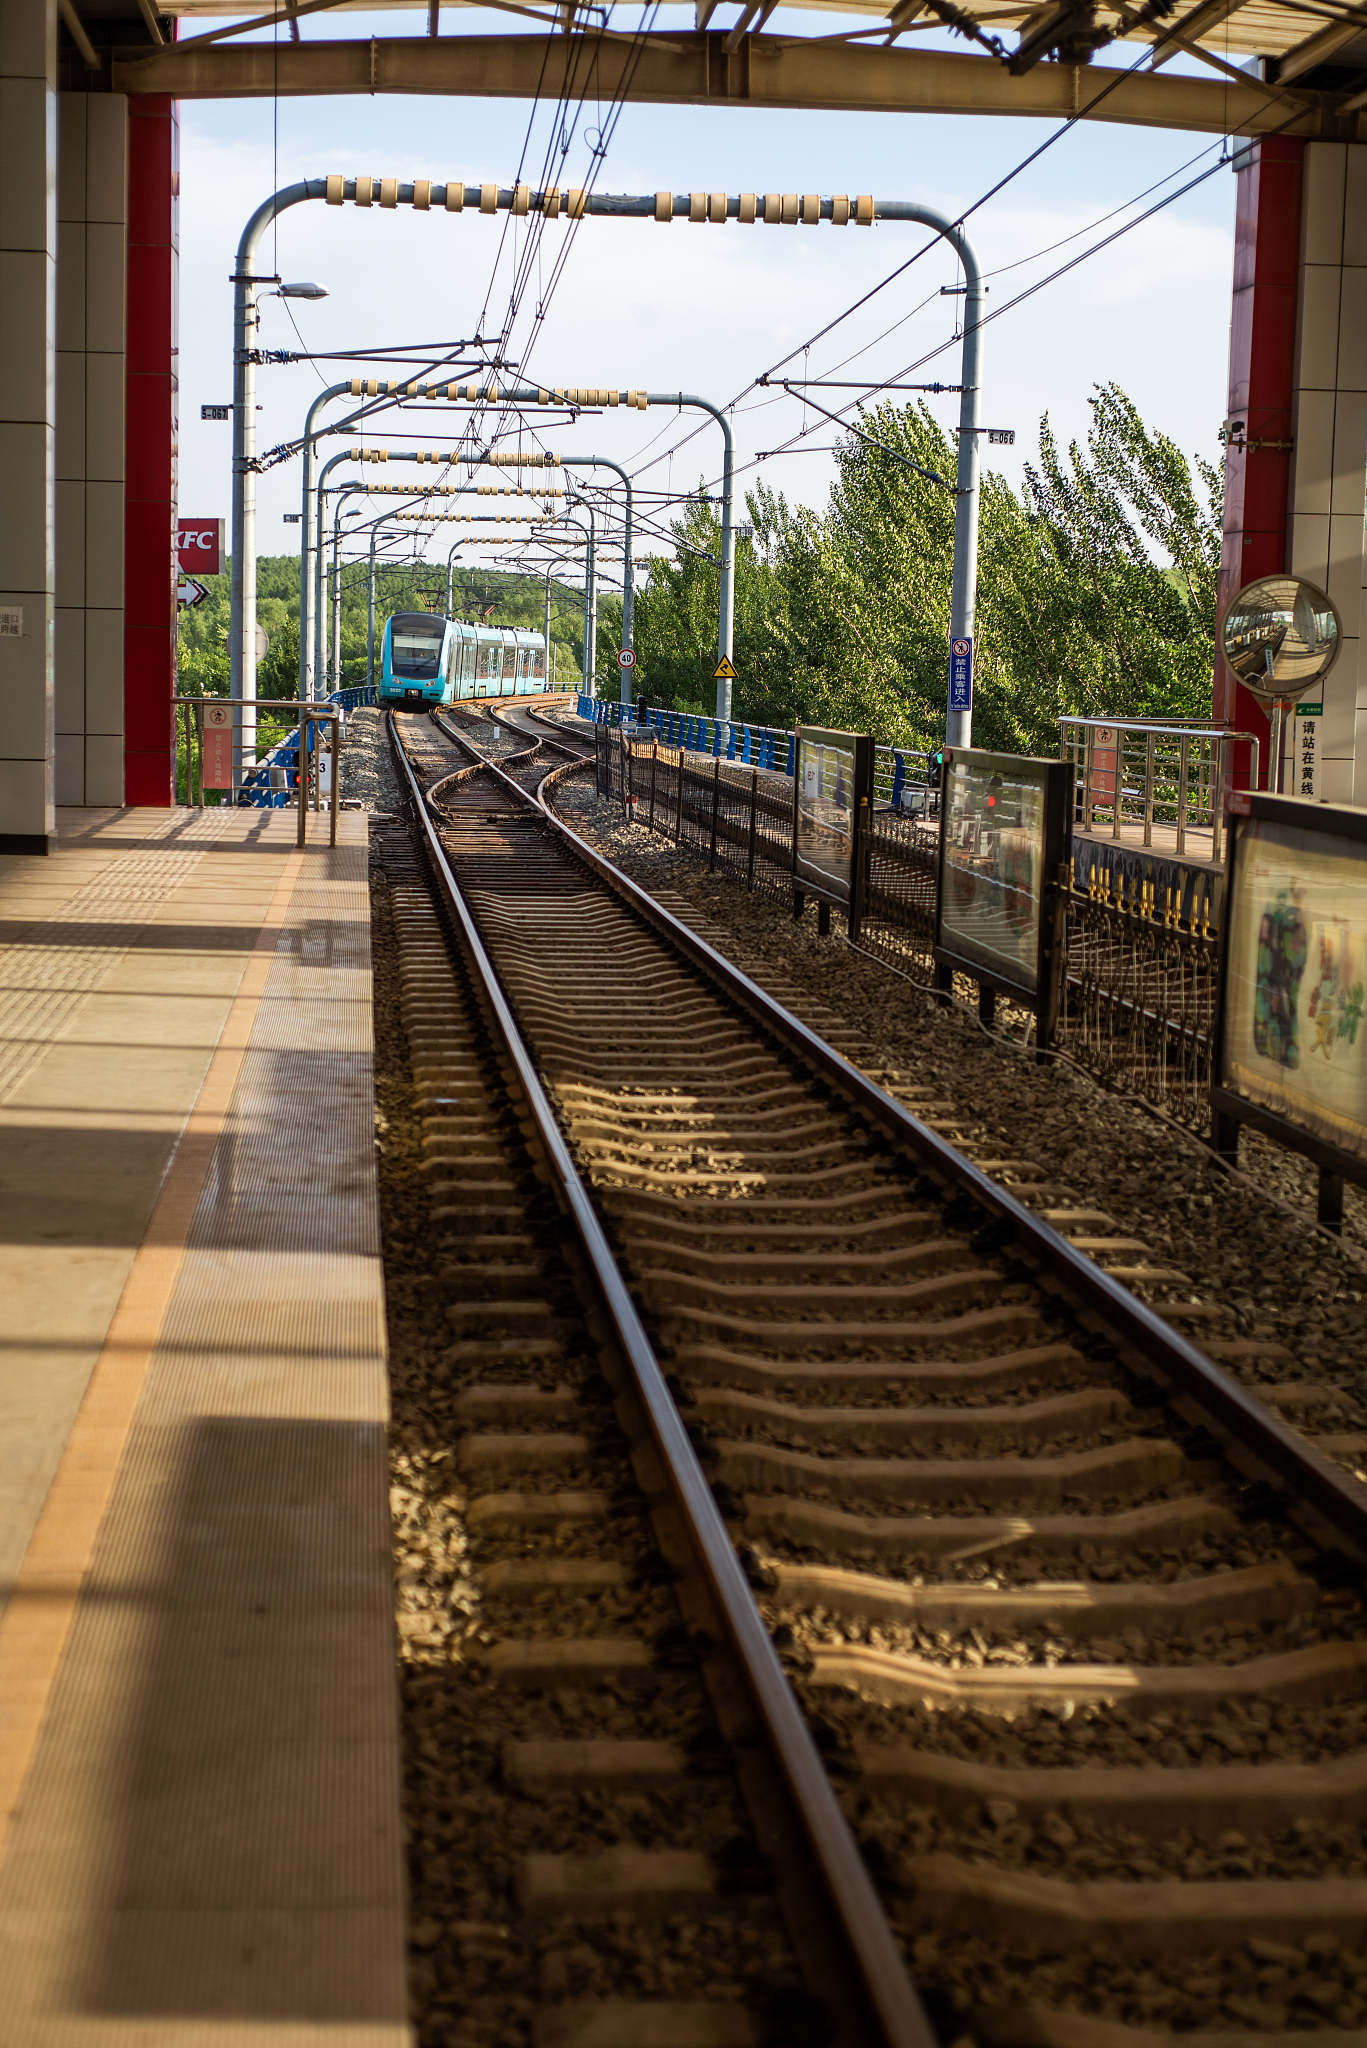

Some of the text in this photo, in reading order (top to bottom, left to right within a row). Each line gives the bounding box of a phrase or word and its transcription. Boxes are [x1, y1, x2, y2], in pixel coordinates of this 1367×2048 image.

[202, 409, 227, 419] 5-067
[990, 432, 1014, 444] 5-066
[621, 654, 632, 662] 40
[955, 658, 967, 703] 禁止乘客进入
[1301, 721, 1315, 796] 请站在黄线
[319, 763, 326, 773] 3
